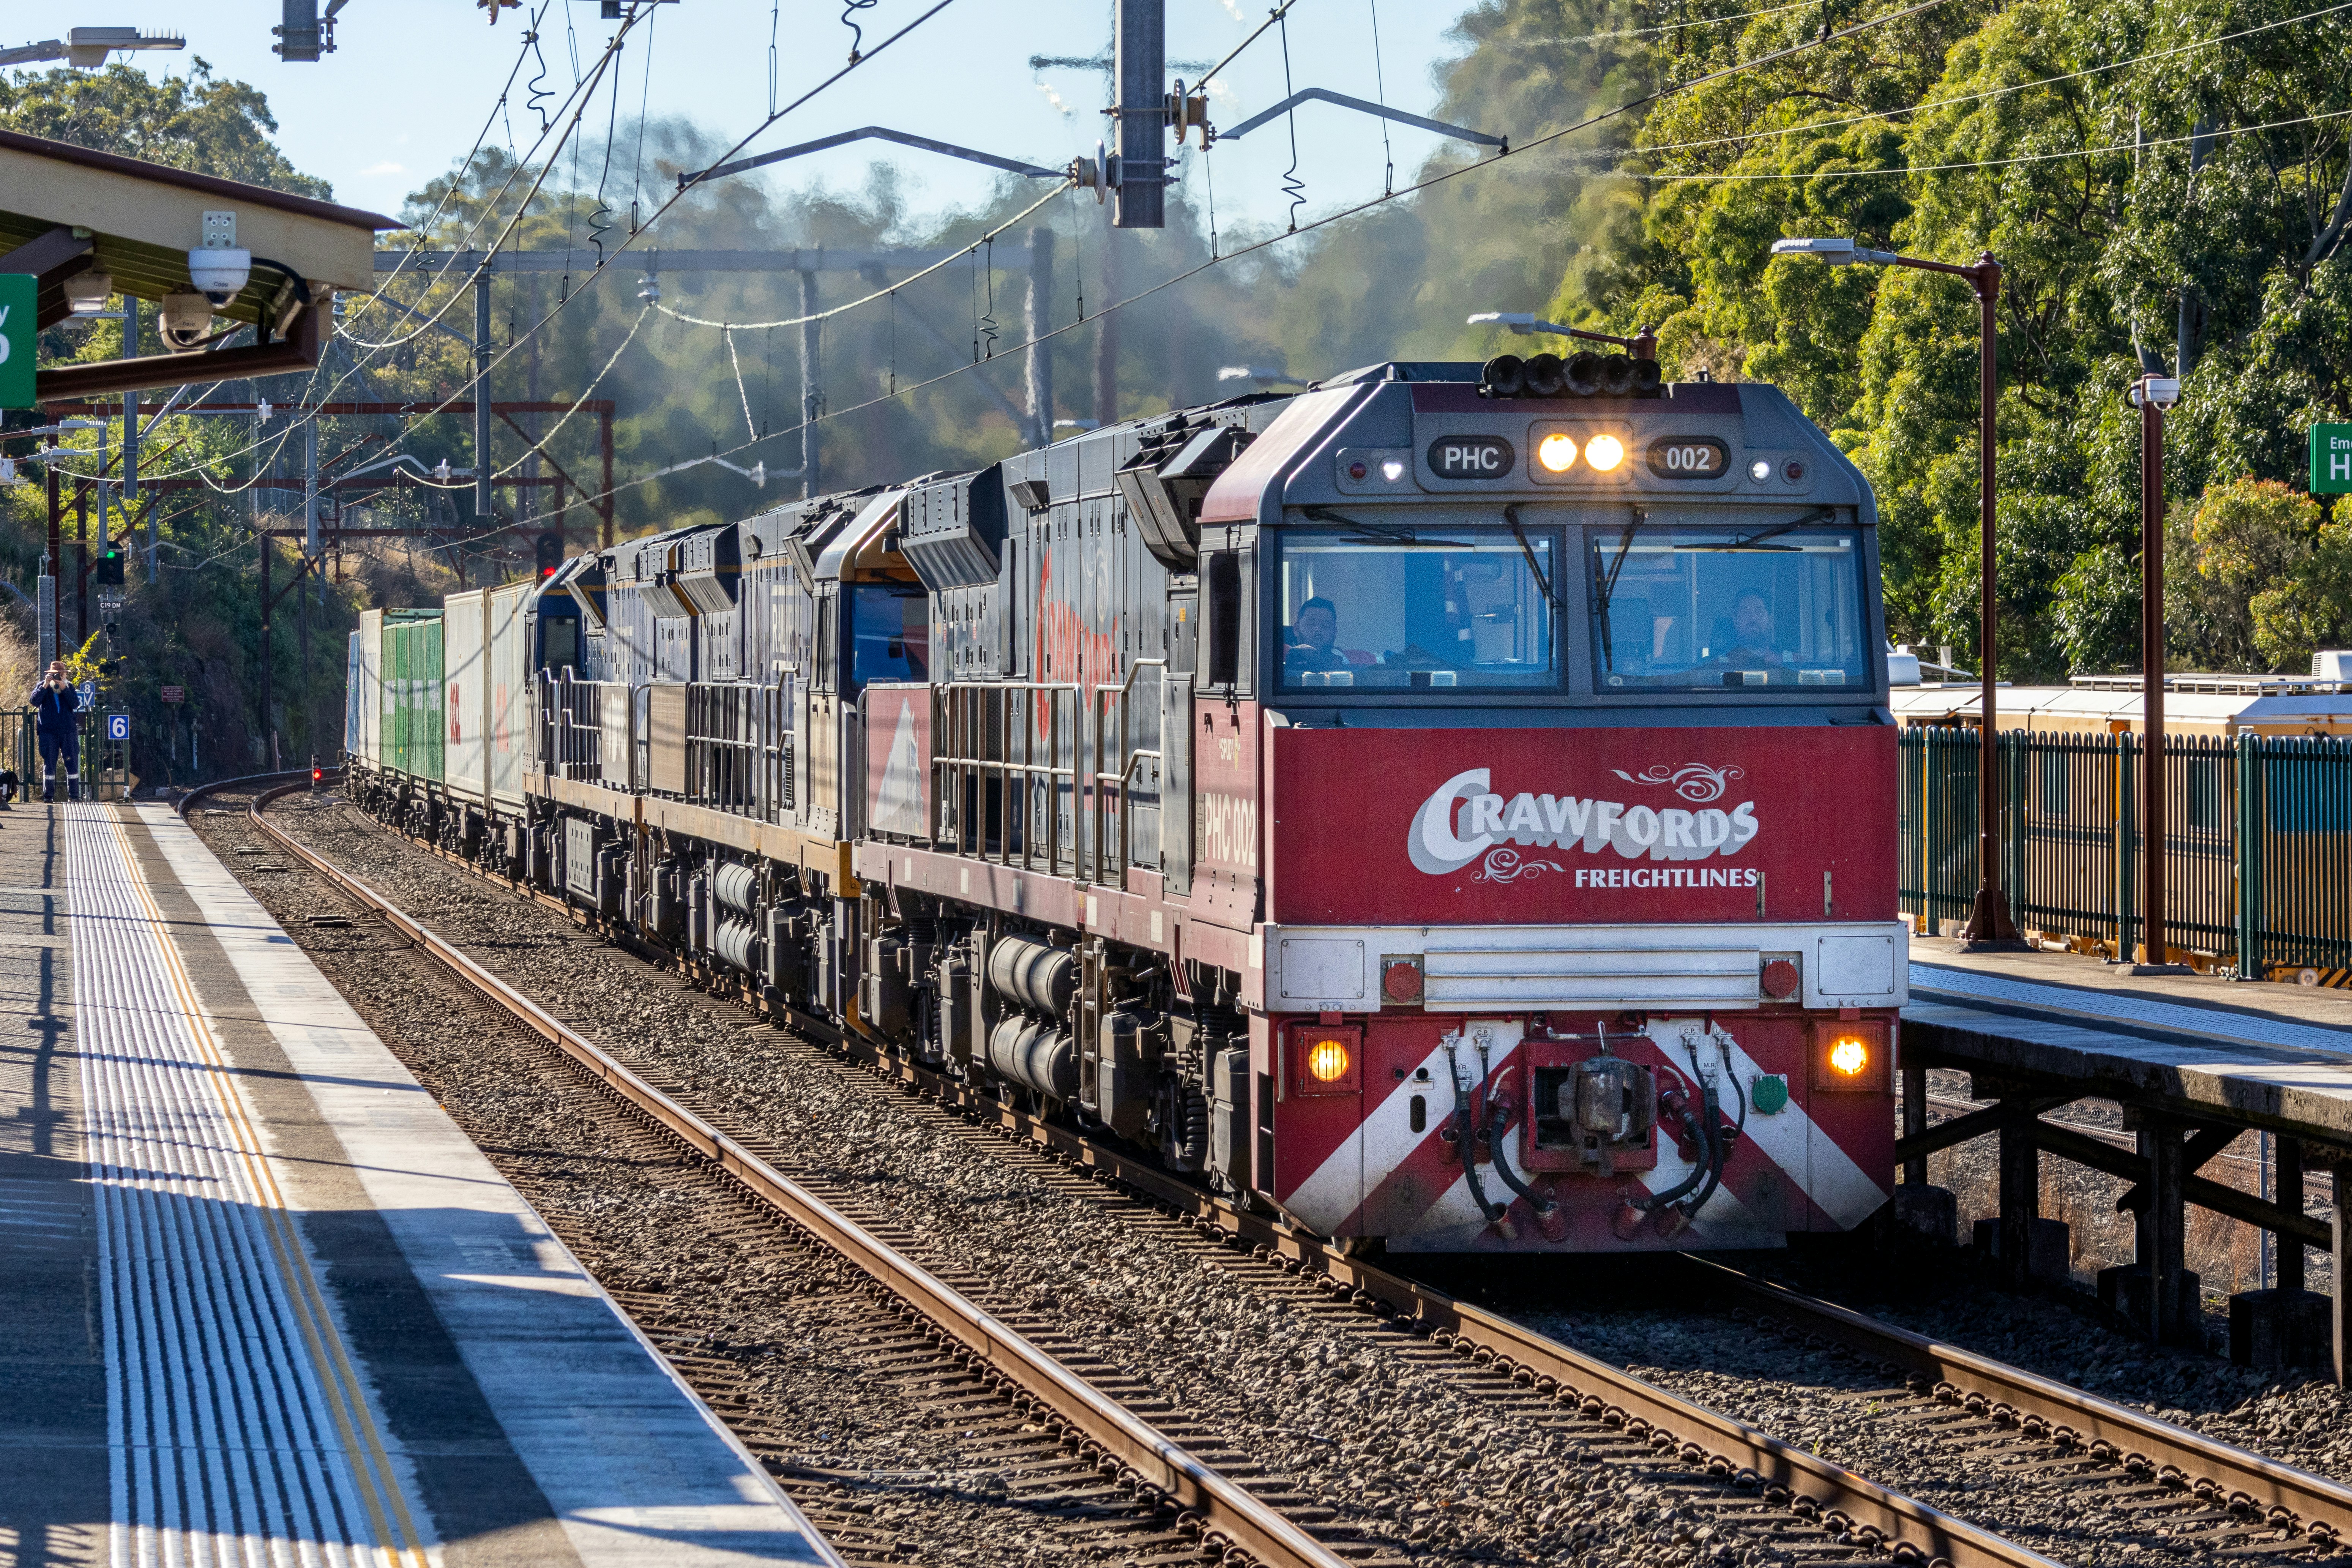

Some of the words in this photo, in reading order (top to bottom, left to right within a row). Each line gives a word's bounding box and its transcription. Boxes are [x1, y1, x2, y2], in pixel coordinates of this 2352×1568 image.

[1445, 447, 1499, 470] PHC
[1667, 447, 1710, 470] 002
[84, 684, 91, 694] 8
[113, 718, 126, 737] 6
[1205, 792, 1230, 862] PHC
[1233, 798, 1256, 867] 002
[1409, 768, 1759, 874] CRAWFORDS
[1576, 868, 1757, 888] FREIGHTLINES
